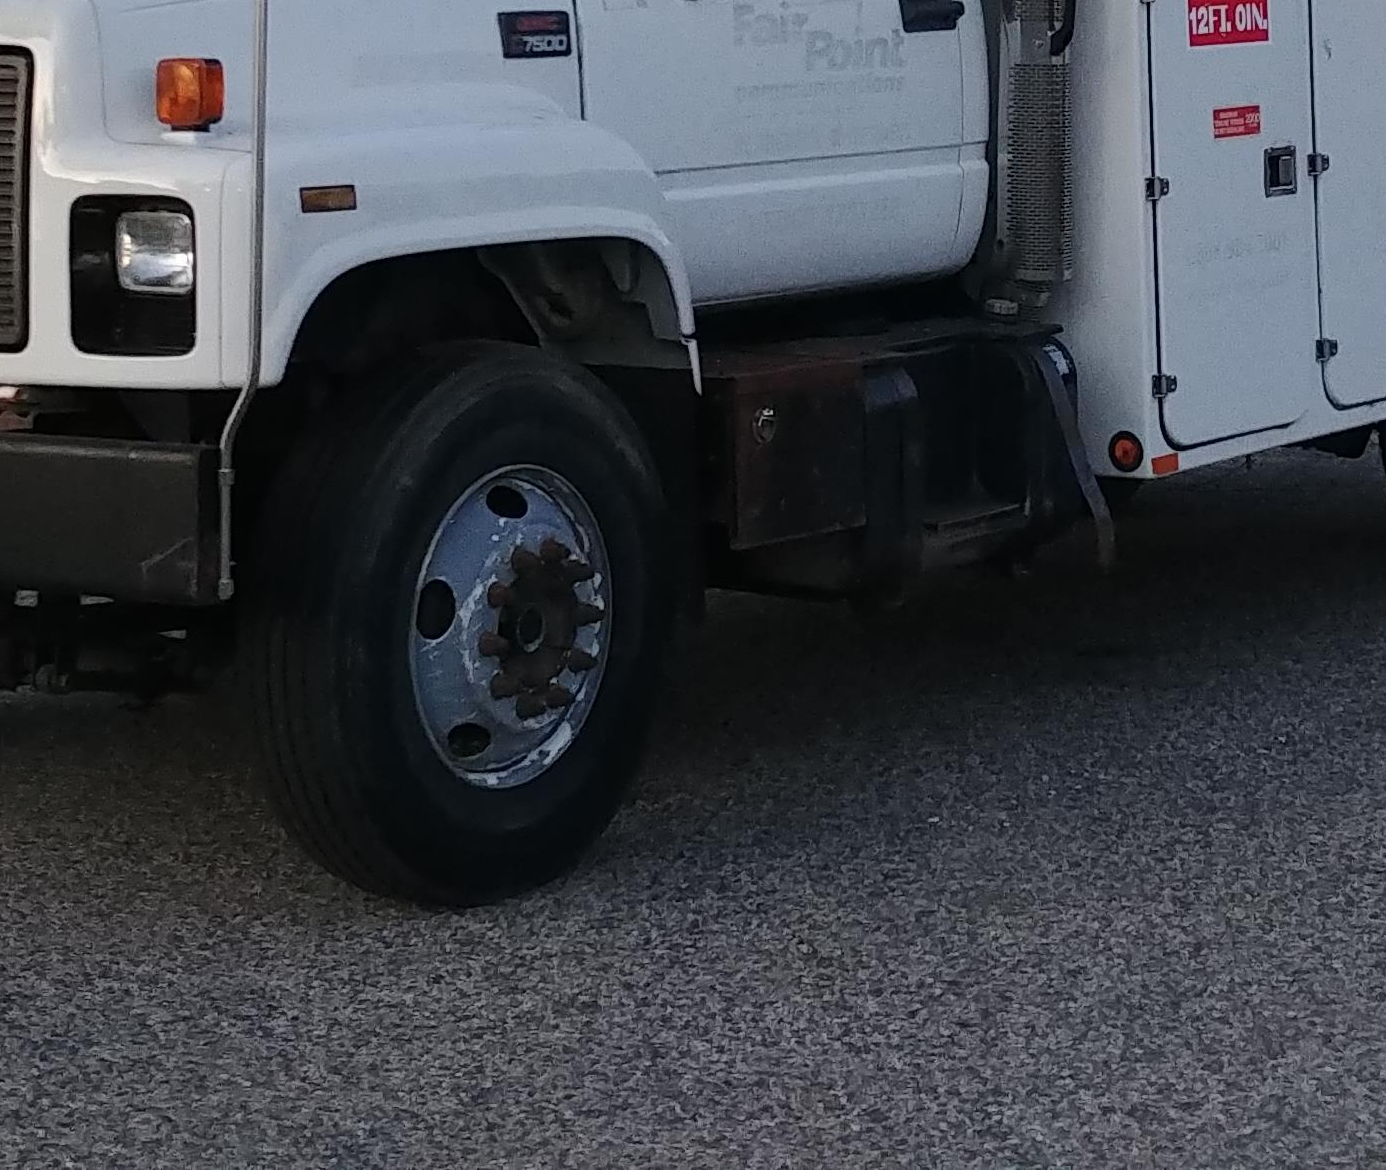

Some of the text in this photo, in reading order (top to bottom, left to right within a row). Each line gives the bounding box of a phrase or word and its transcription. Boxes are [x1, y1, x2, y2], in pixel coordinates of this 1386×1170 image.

[522, 34, 568, 52] 7500
[733, 0, 809, 47] Fair
[805, 28, 907, 72] Point
